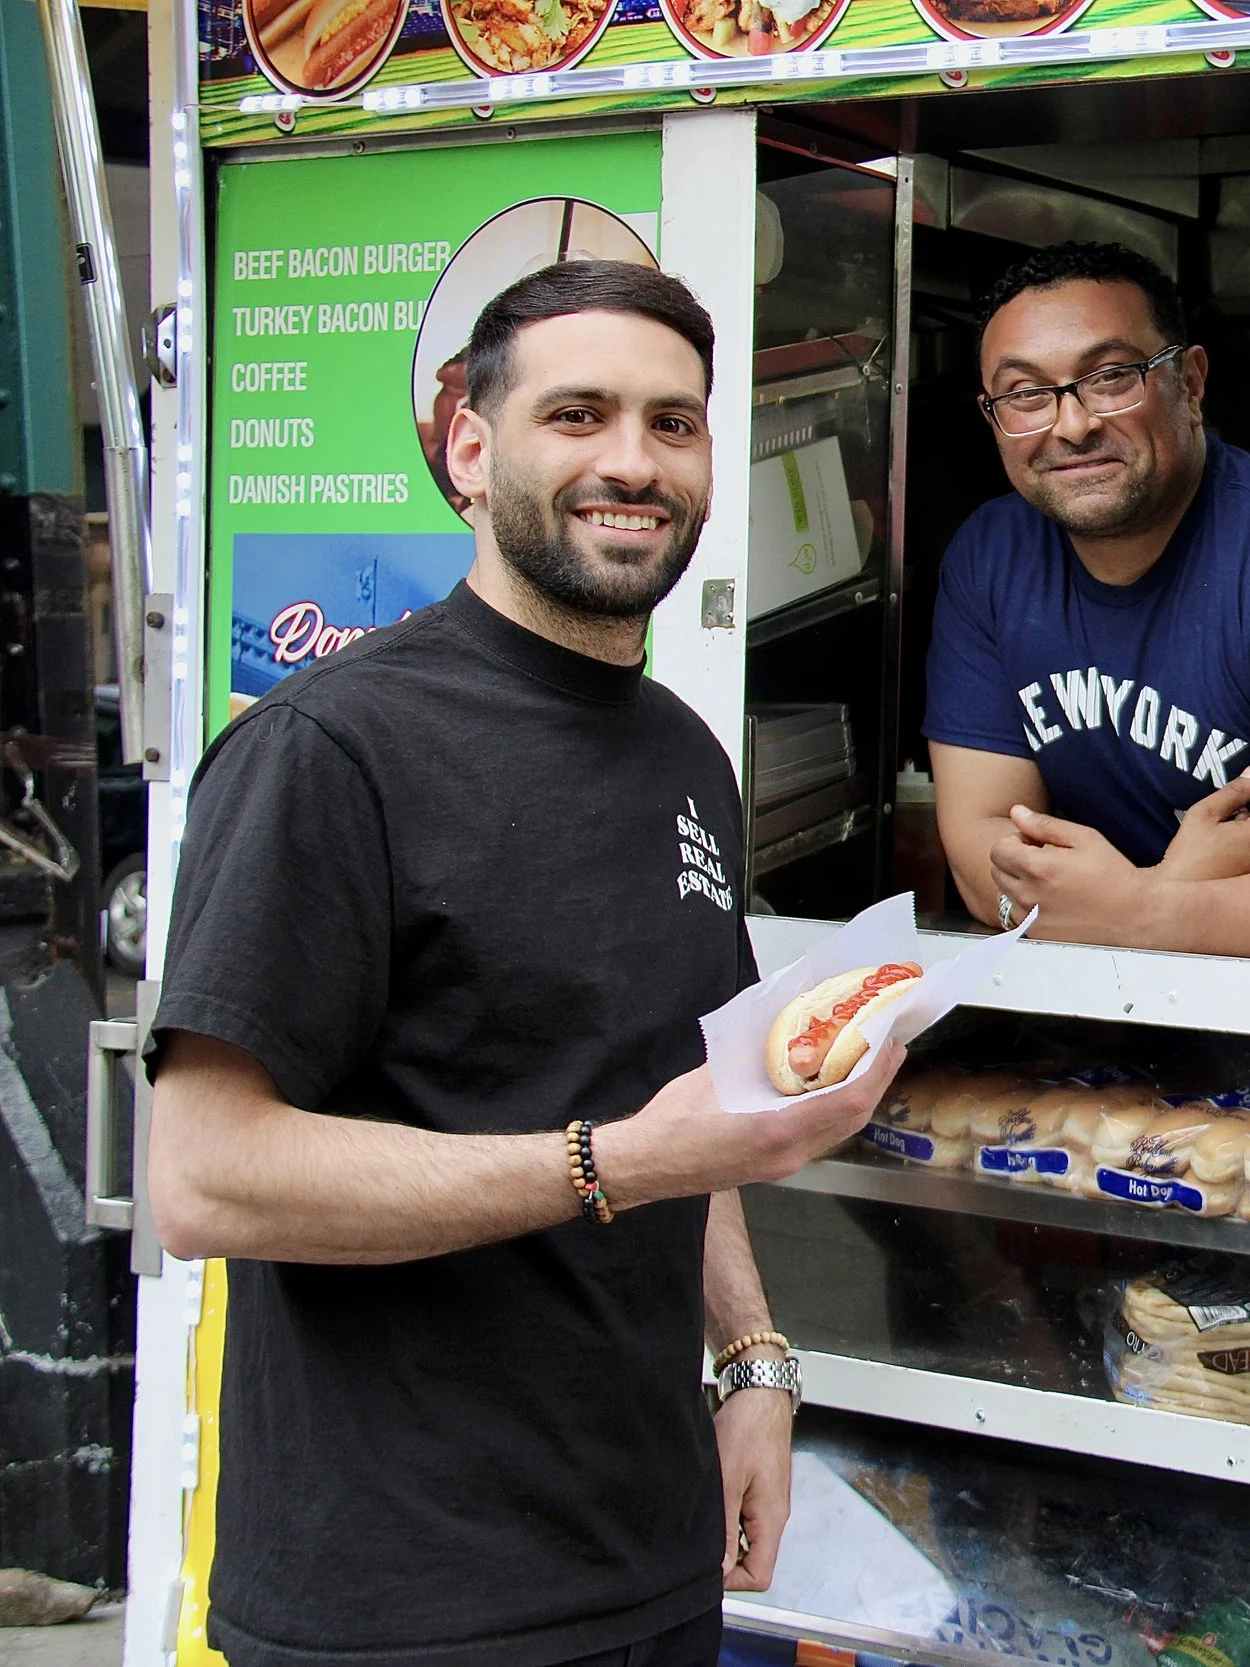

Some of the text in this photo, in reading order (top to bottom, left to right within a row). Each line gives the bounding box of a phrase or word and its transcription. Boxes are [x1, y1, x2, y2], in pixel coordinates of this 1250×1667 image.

[234, 241, 451, 280] BEEF BACON BURGER
[233, 300, 428, 336] TURKEY BACON BU
[232, 362, 307, 392] COFFEE
[231, 418, 314, 448] DONUTS
[229, 473, 408, 504] DANISH PASTRIES
[687, 796, 698, 819] I
[677, 815, 719, 856] SELL
[679, 843, 725, 883] REAL
[874, 1128, 905, 1151] Hot Dog
[1129, 1180, 1173, 1201] Hot Dog
